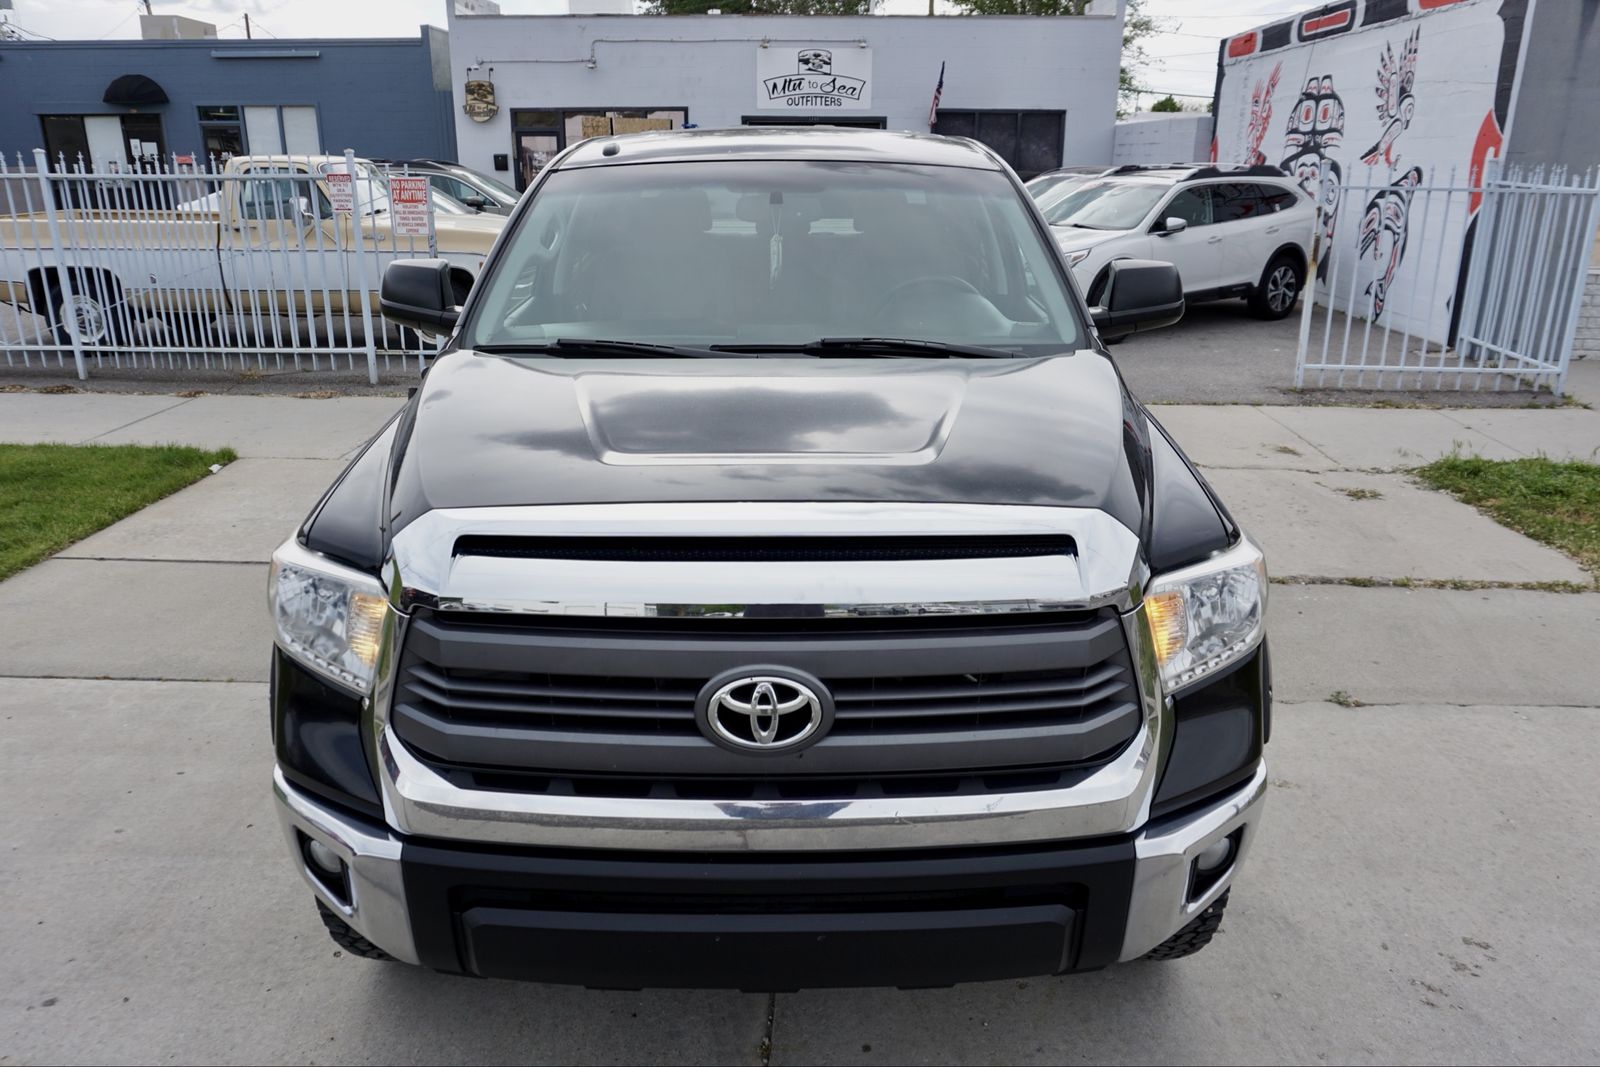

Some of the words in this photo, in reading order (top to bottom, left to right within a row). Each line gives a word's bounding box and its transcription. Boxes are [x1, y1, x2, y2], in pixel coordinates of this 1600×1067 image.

[808, 80, 818, 89] to
[820, 77, 857, 96] Sea
[786, 95, 842, 106] OUTFITTERS
[391, 180, 400, 189] NO
[401, 180, 426, 189] PARKING
[393, 190, 401, 200] AT
[401, 190, 426, 200] ANYTIME
